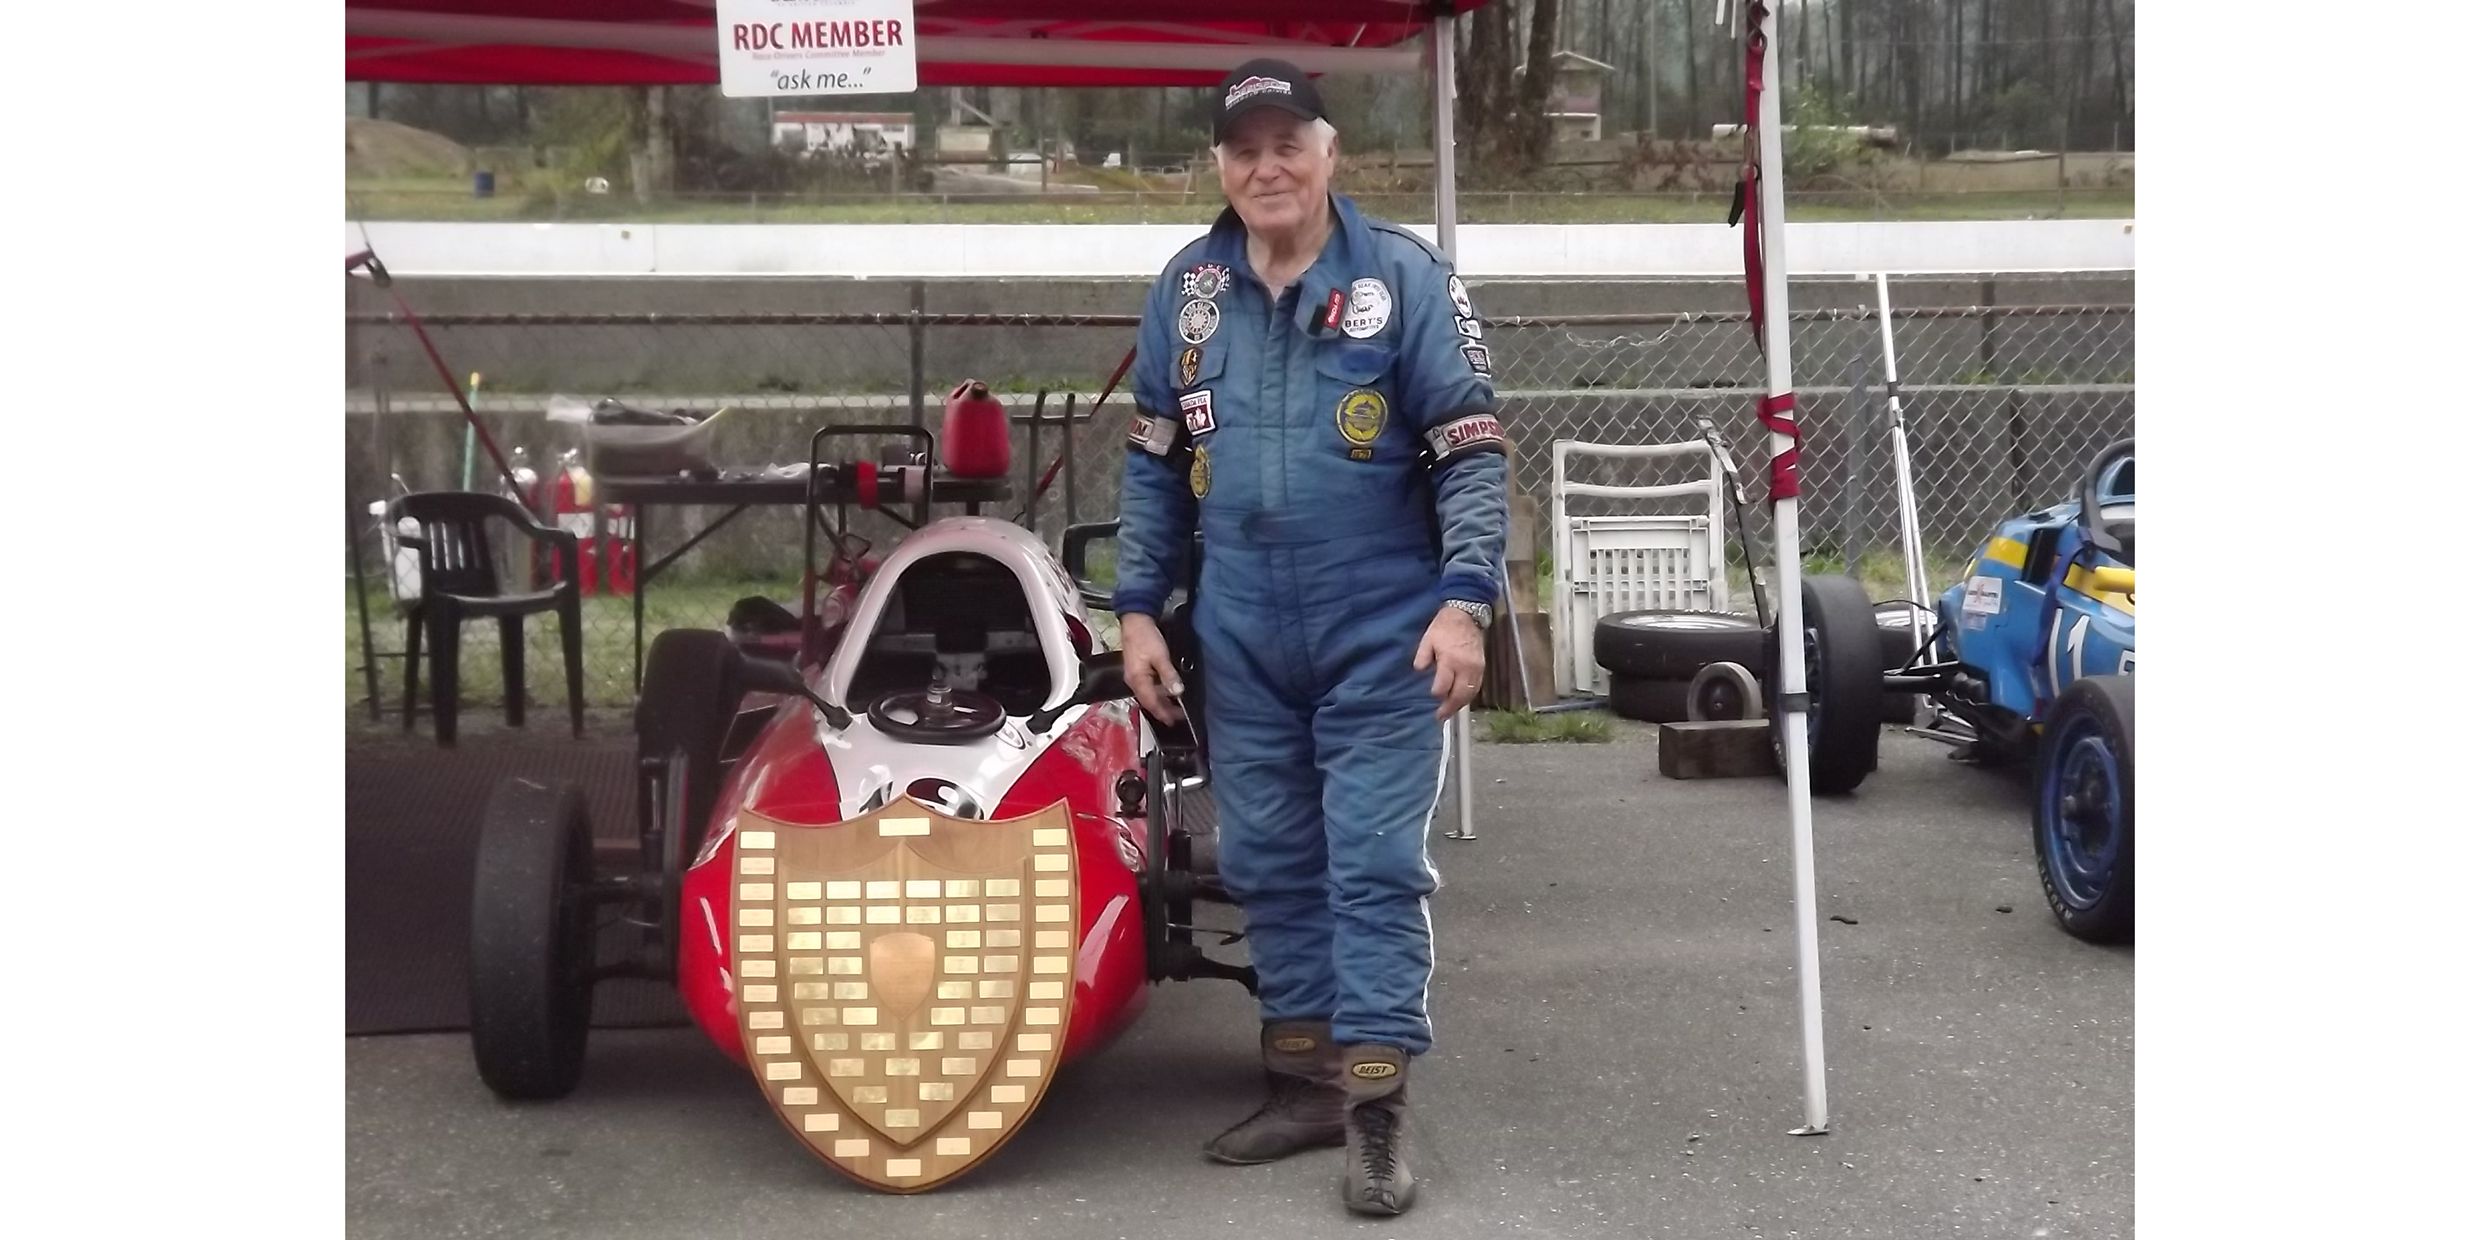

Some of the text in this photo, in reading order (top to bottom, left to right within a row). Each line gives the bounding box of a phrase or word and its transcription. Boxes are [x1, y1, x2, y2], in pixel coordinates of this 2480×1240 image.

[733, 19, 904, 51] RDC MEMBER
[852, 49, 885, 58] Member
[1344, 316, 1383, 328] BERT'S
[1447, 420, 1506, 445] SIMPS
